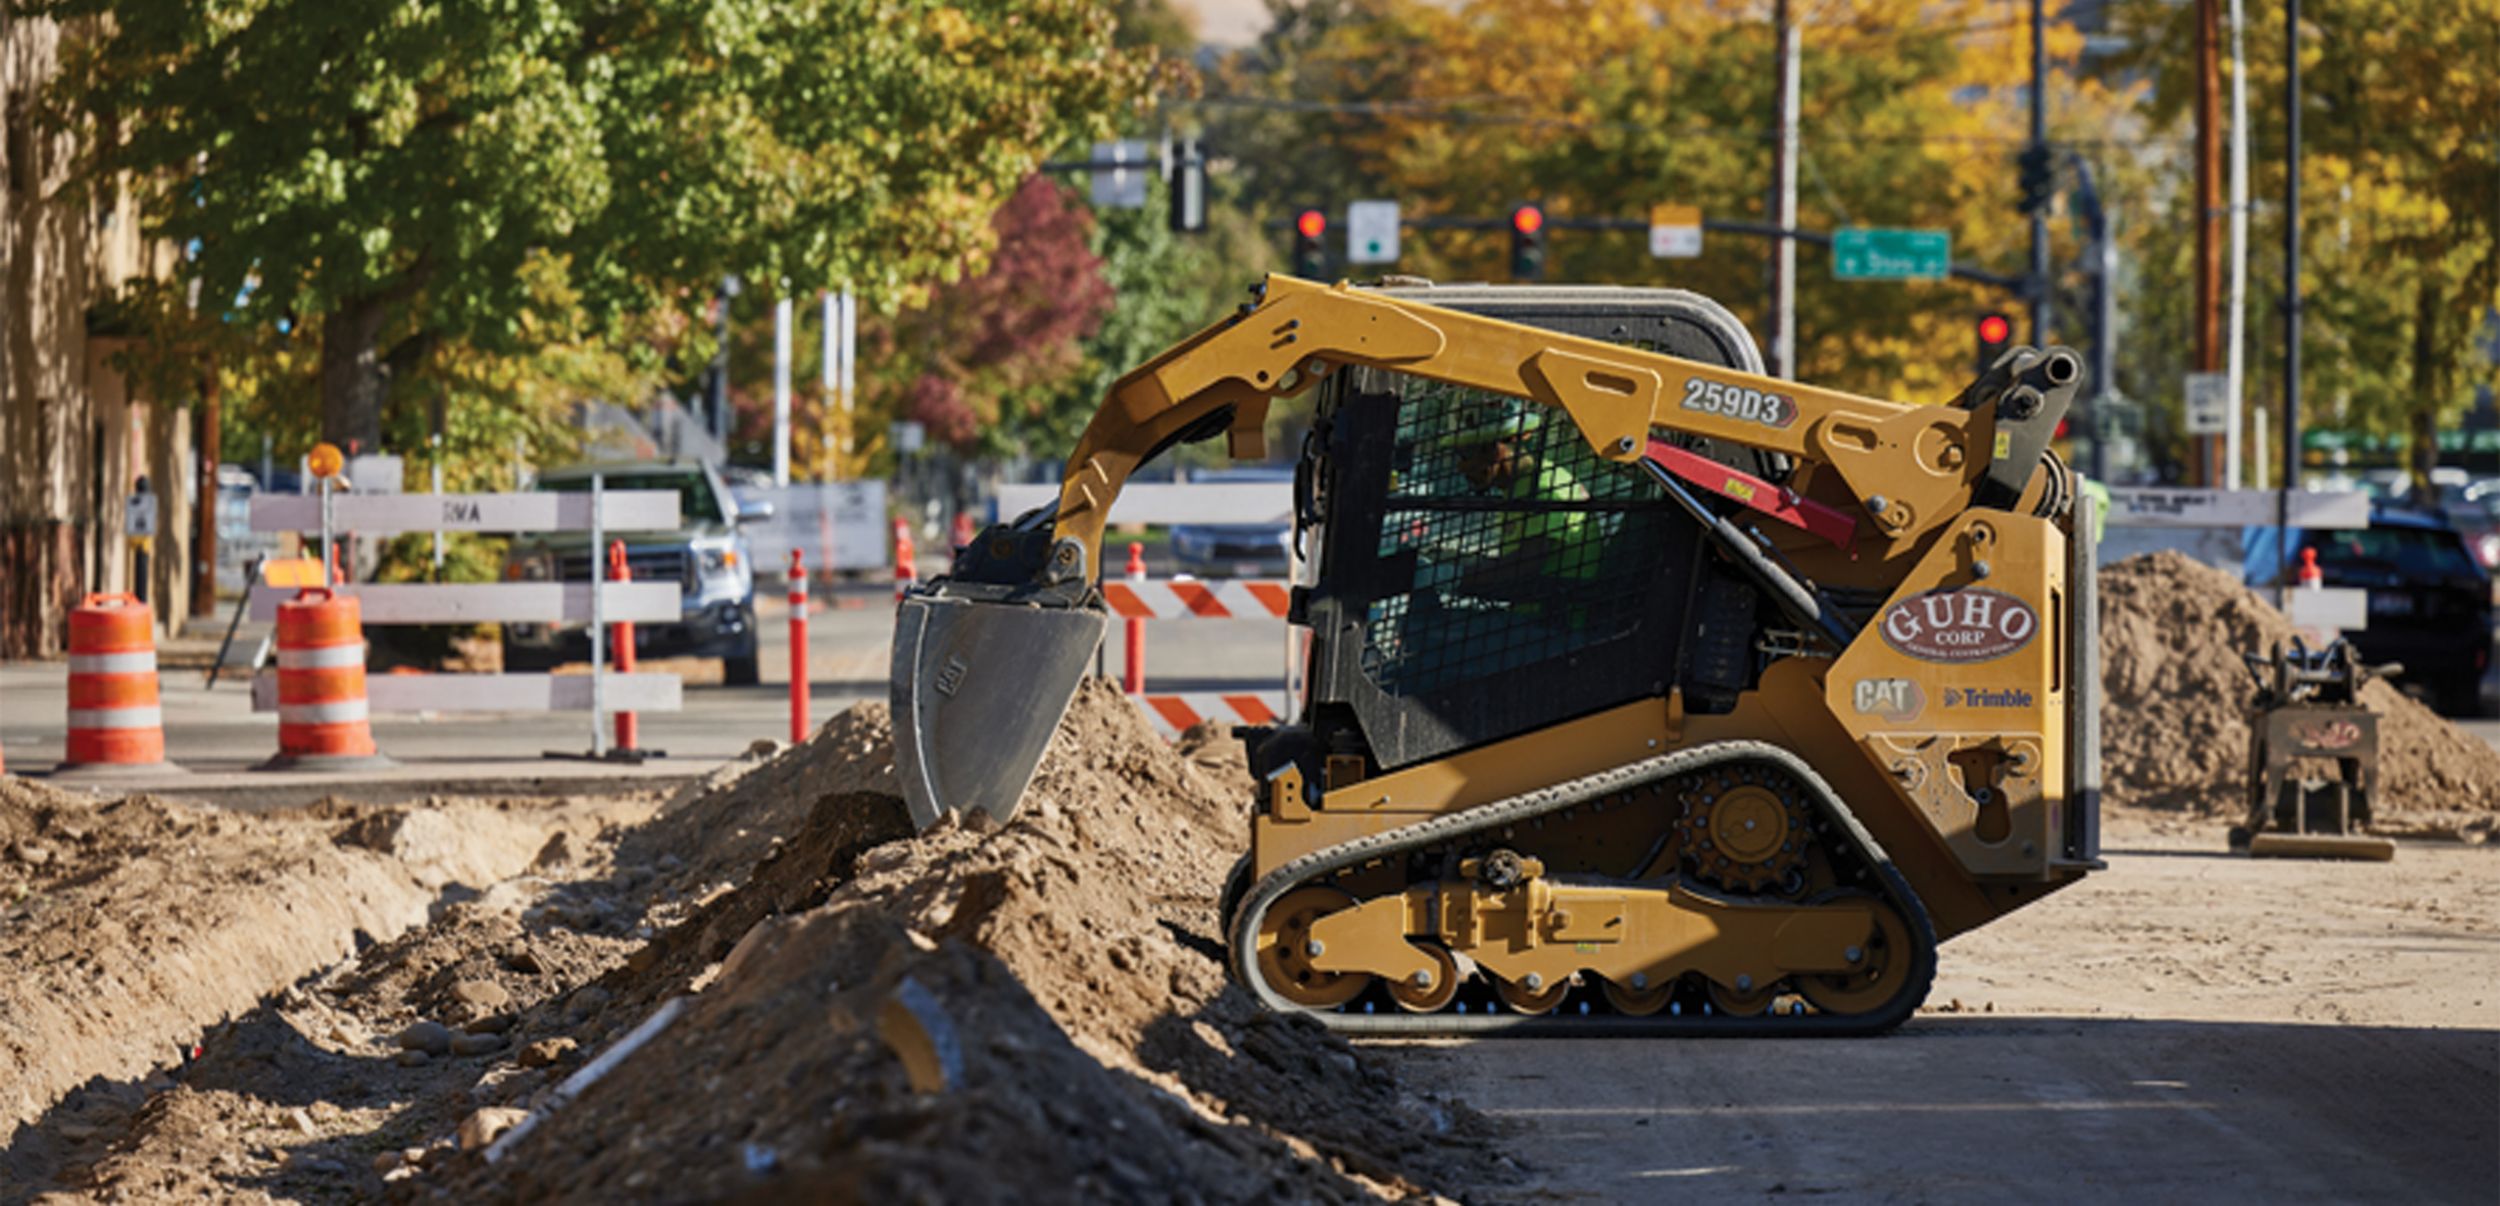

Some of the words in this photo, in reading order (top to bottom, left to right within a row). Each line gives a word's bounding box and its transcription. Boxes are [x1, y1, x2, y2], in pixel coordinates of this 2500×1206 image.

[1683, 378, 1781, 423] 259D3
[1886, 593, 2033, 642] GUHO
[1934, 630, 1986, 645] CORP
[1855, 679, 1909, 713] CAT
[1964, 687, 2032, 708] Trimble
